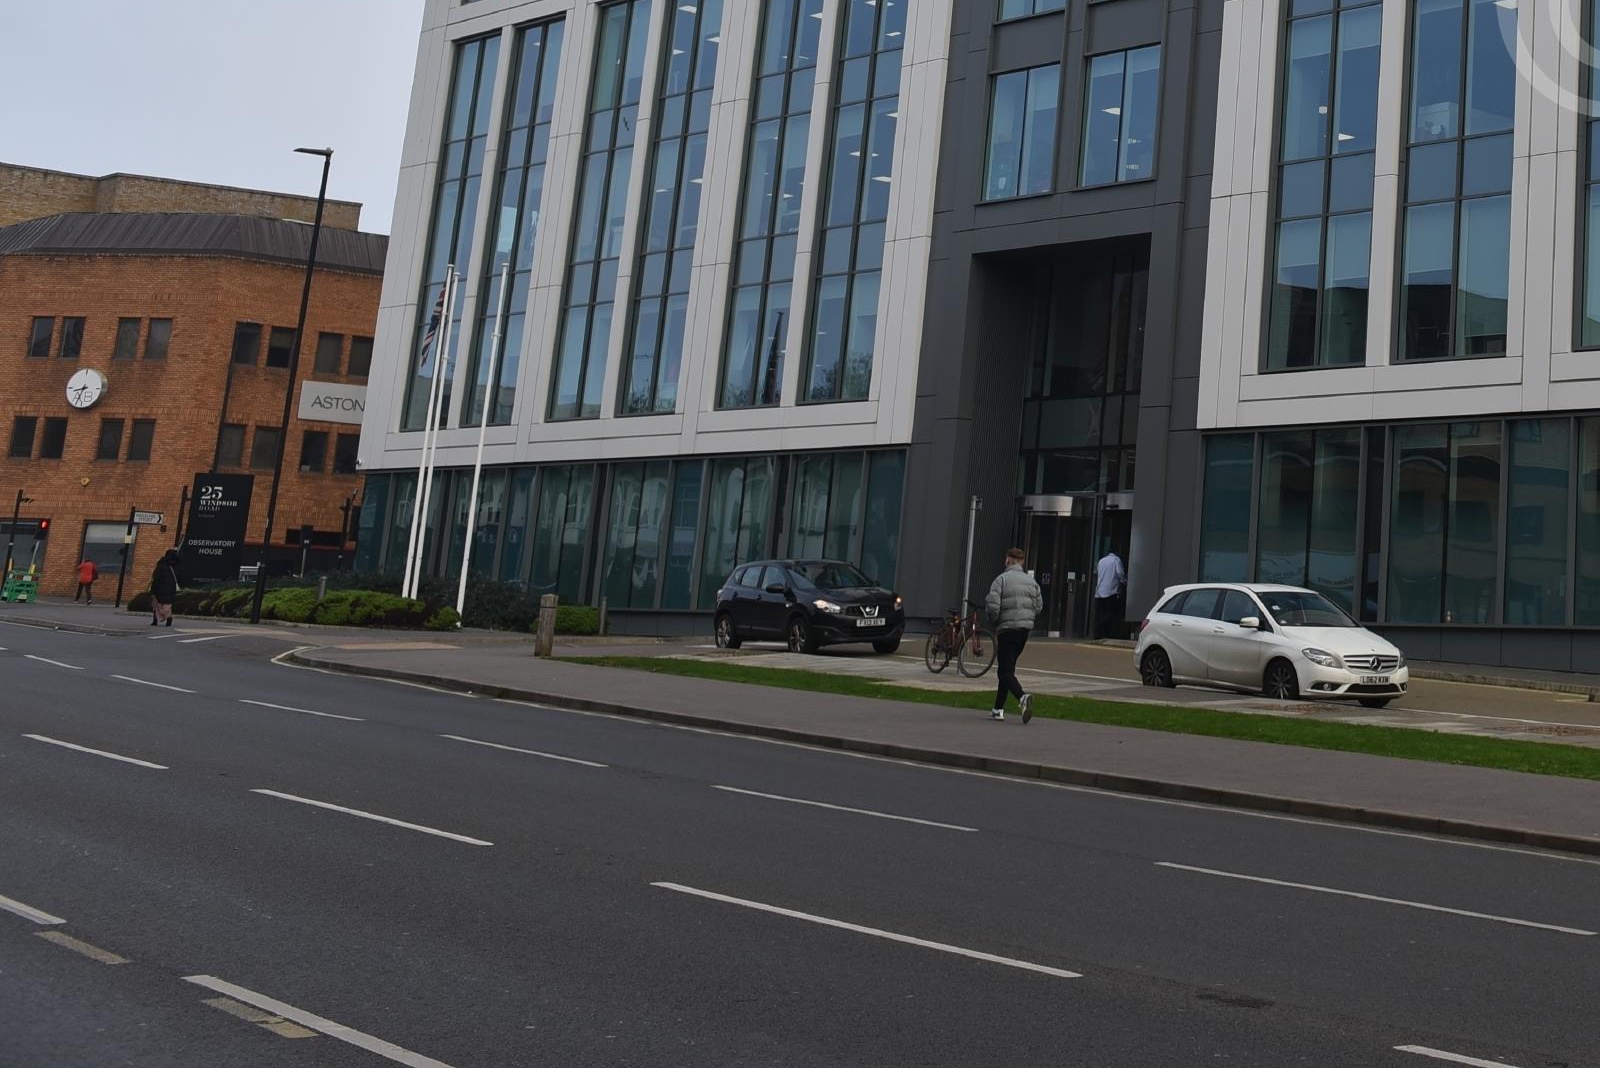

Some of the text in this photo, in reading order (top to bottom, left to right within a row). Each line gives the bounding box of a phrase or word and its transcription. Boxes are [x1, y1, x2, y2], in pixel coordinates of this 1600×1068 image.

[311, 395, 366, 412] ASTON
[201, 486, 223, 499] 25
[200, 499, 238, 507] WINDSOR
[188, 539, 236, 548] OBSERVATORY
[199, 548, 223, 556] HOUSE
